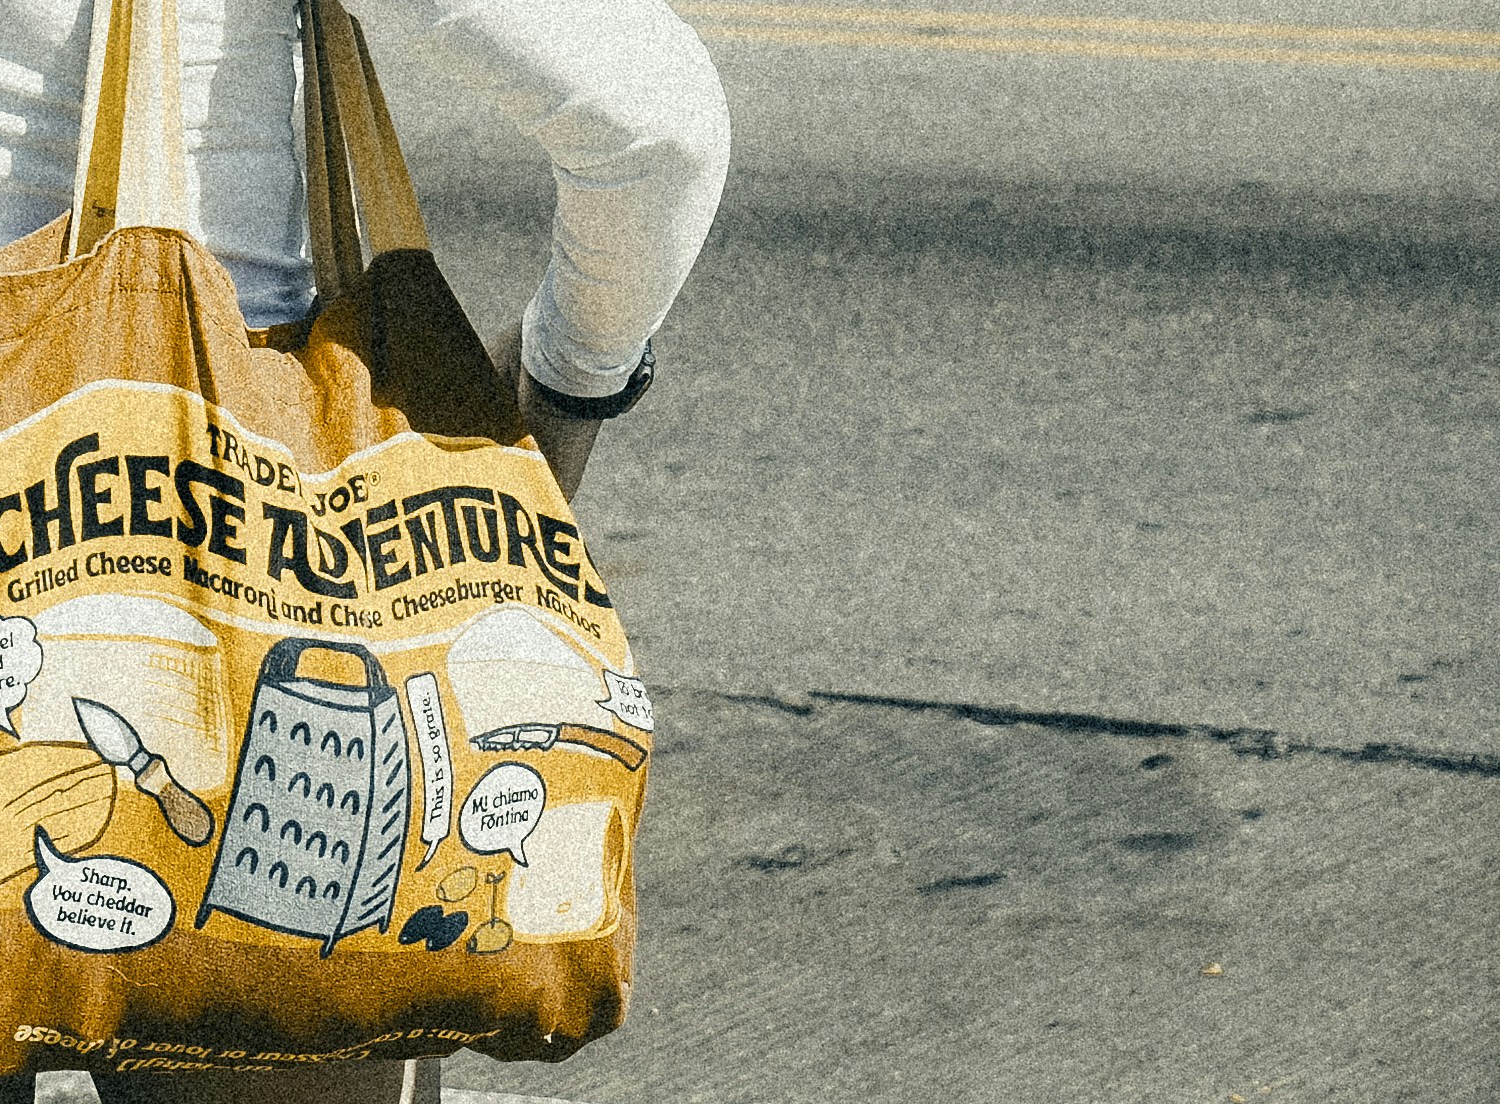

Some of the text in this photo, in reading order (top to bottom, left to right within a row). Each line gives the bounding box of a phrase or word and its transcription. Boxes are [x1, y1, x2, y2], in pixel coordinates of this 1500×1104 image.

[206, 422, 369, 517] TRADE JOE
[262, 485, 614, 609] ADVENTURES
[7, 551, 602, 639] Grilled Cheese Macaroni and Chese Cheeseburger Nachos
[422, 691, 445, 823] This is so grate.
[492, 787, 539, 809] chiamo
[480, 806, 529, 832] Fontina
[80, 866, 132, 894] Sharp.
[86, 890, 153, 918] cheddar
[56, 906, 136, 936] believe it.
[13, 1023, 106, 1055] cheese
[141, 1040, 212, 1059] lover
